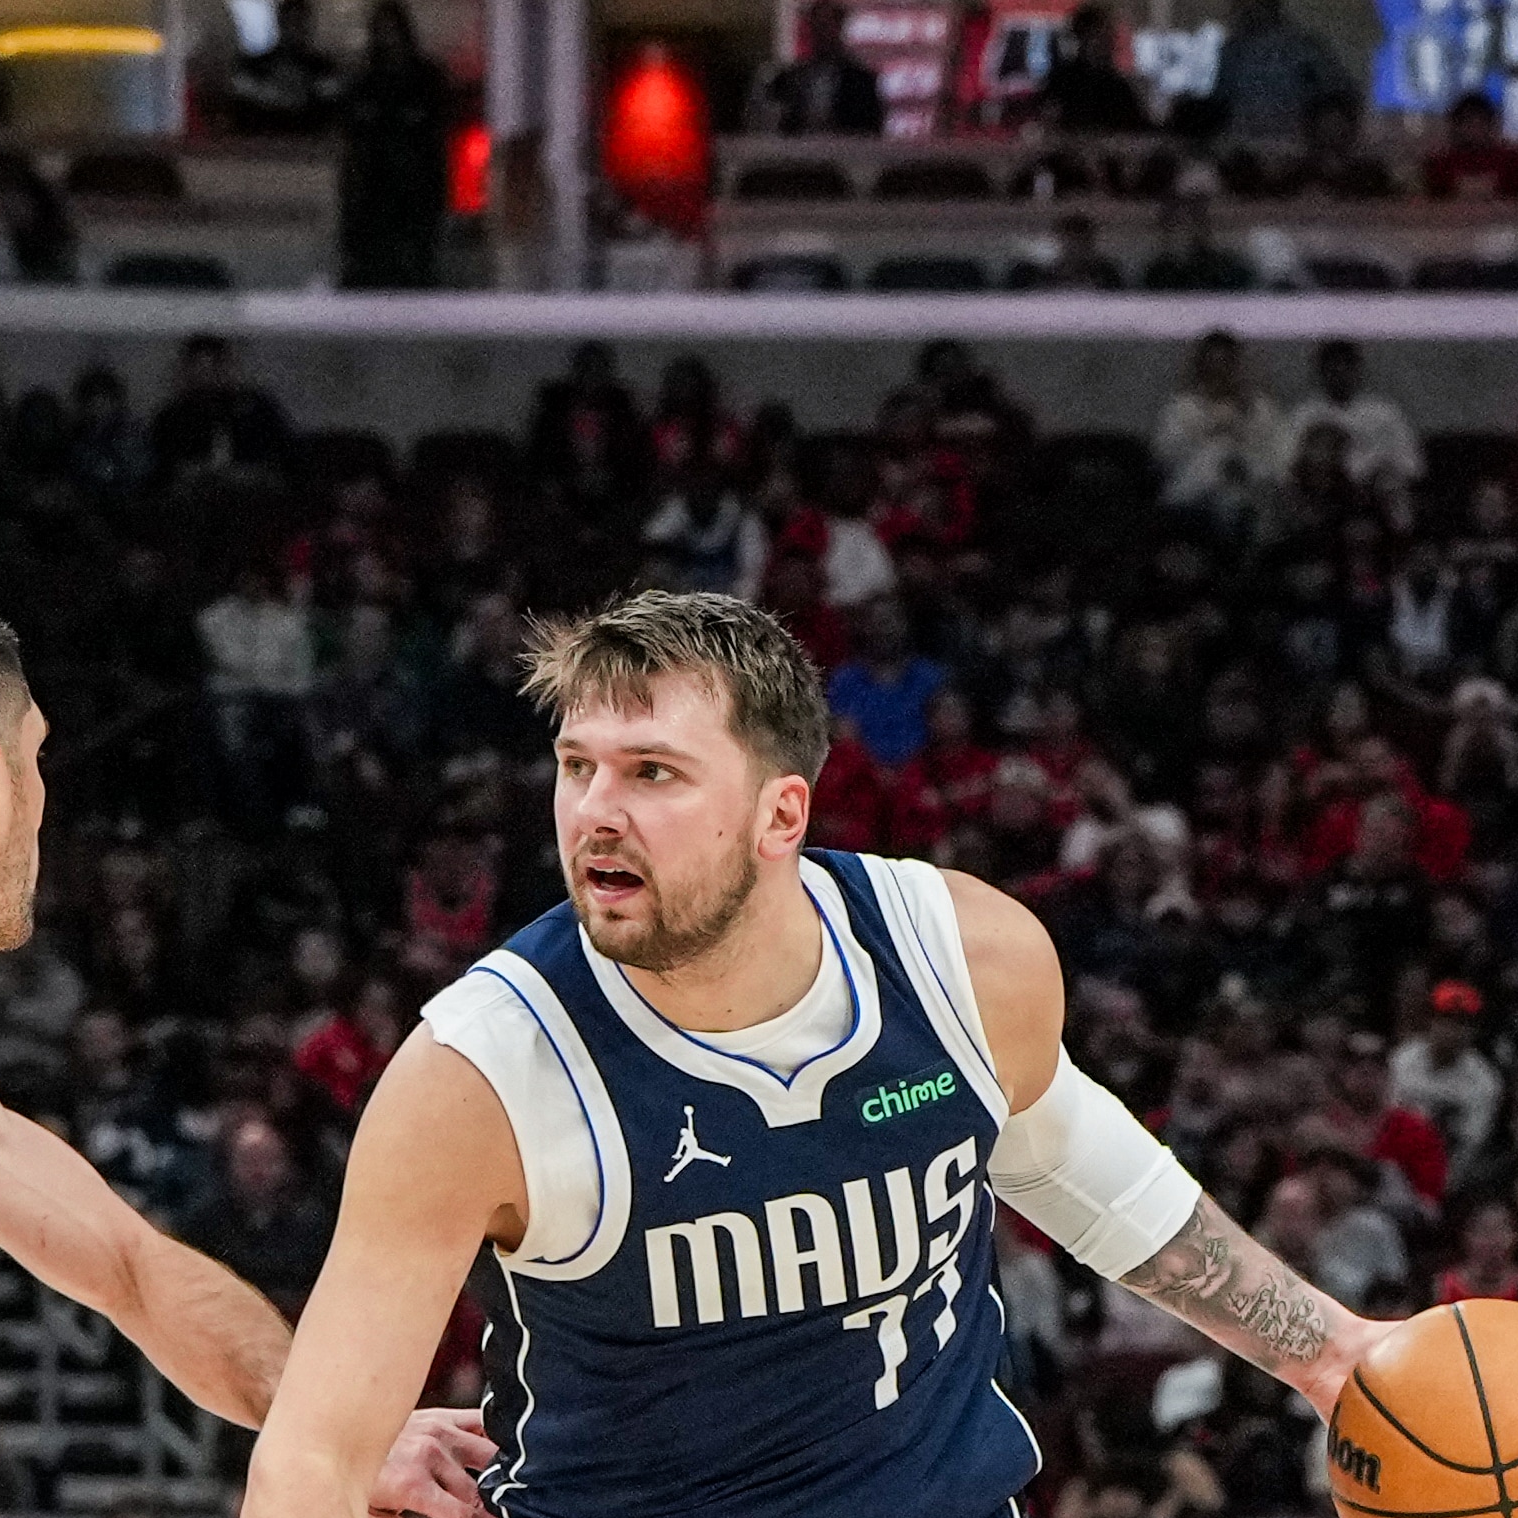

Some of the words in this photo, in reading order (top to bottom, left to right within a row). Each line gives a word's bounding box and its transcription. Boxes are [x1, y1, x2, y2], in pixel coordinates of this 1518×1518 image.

[862, 1072, 956, 1123] chime
[645, 1136, 977, 1329] MAVS
[843, 1251, 963, 1410] 77
